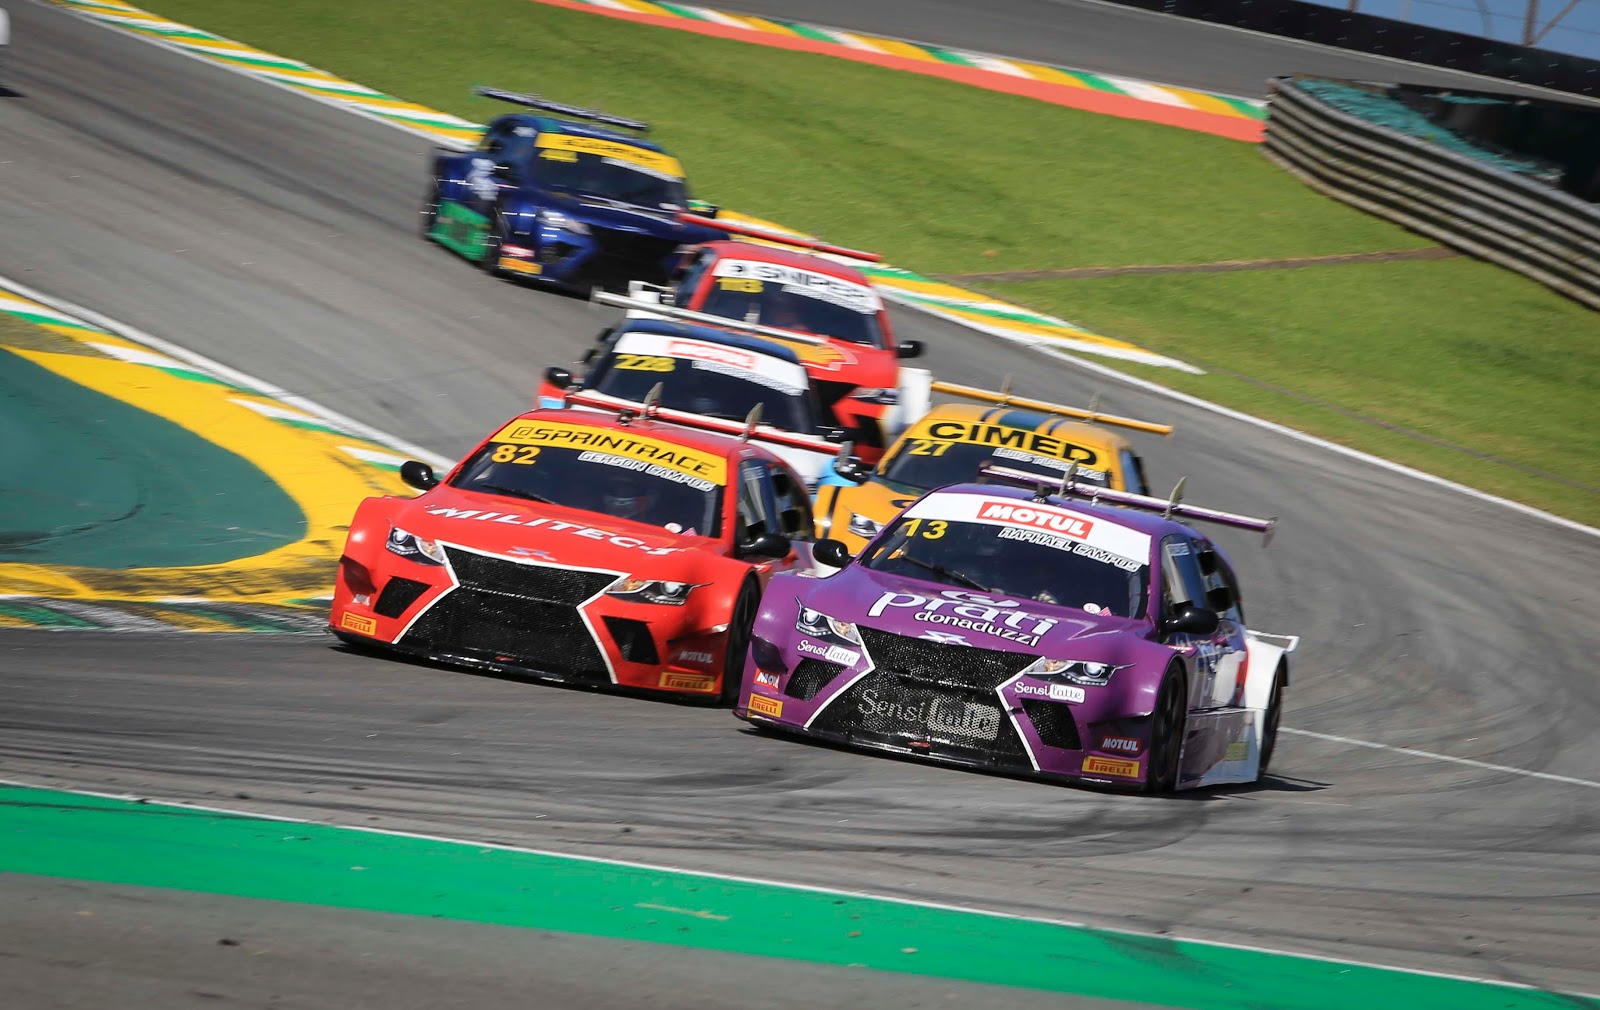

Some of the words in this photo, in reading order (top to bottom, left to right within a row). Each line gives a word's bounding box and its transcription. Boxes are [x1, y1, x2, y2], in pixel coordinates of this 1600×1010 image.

[491, 444, 541, 465] 82
[509, 426, 716, 476] @SPRINTRACE
[908, 440, 955, 457] 27
[928, 422, 1097, 465] CIMED
[577, 451, 650, 472] GERSON
[902, 518, 948, 540] 13
[981, 504, 1088, 537] MOTUL
[998, 526, 1072, 551] RAPHAEL
[1073, 543, 1142, 573] CAMPOS
[867, 591, 1059, 636] prati
[914, 611, 1041, 648] donaduzzi
[752, 697, 779, 715] PIRELLI
[1102, 738, 1139, 752] MOTUL
[1088, 758, 1134, 775] PIRELLI
